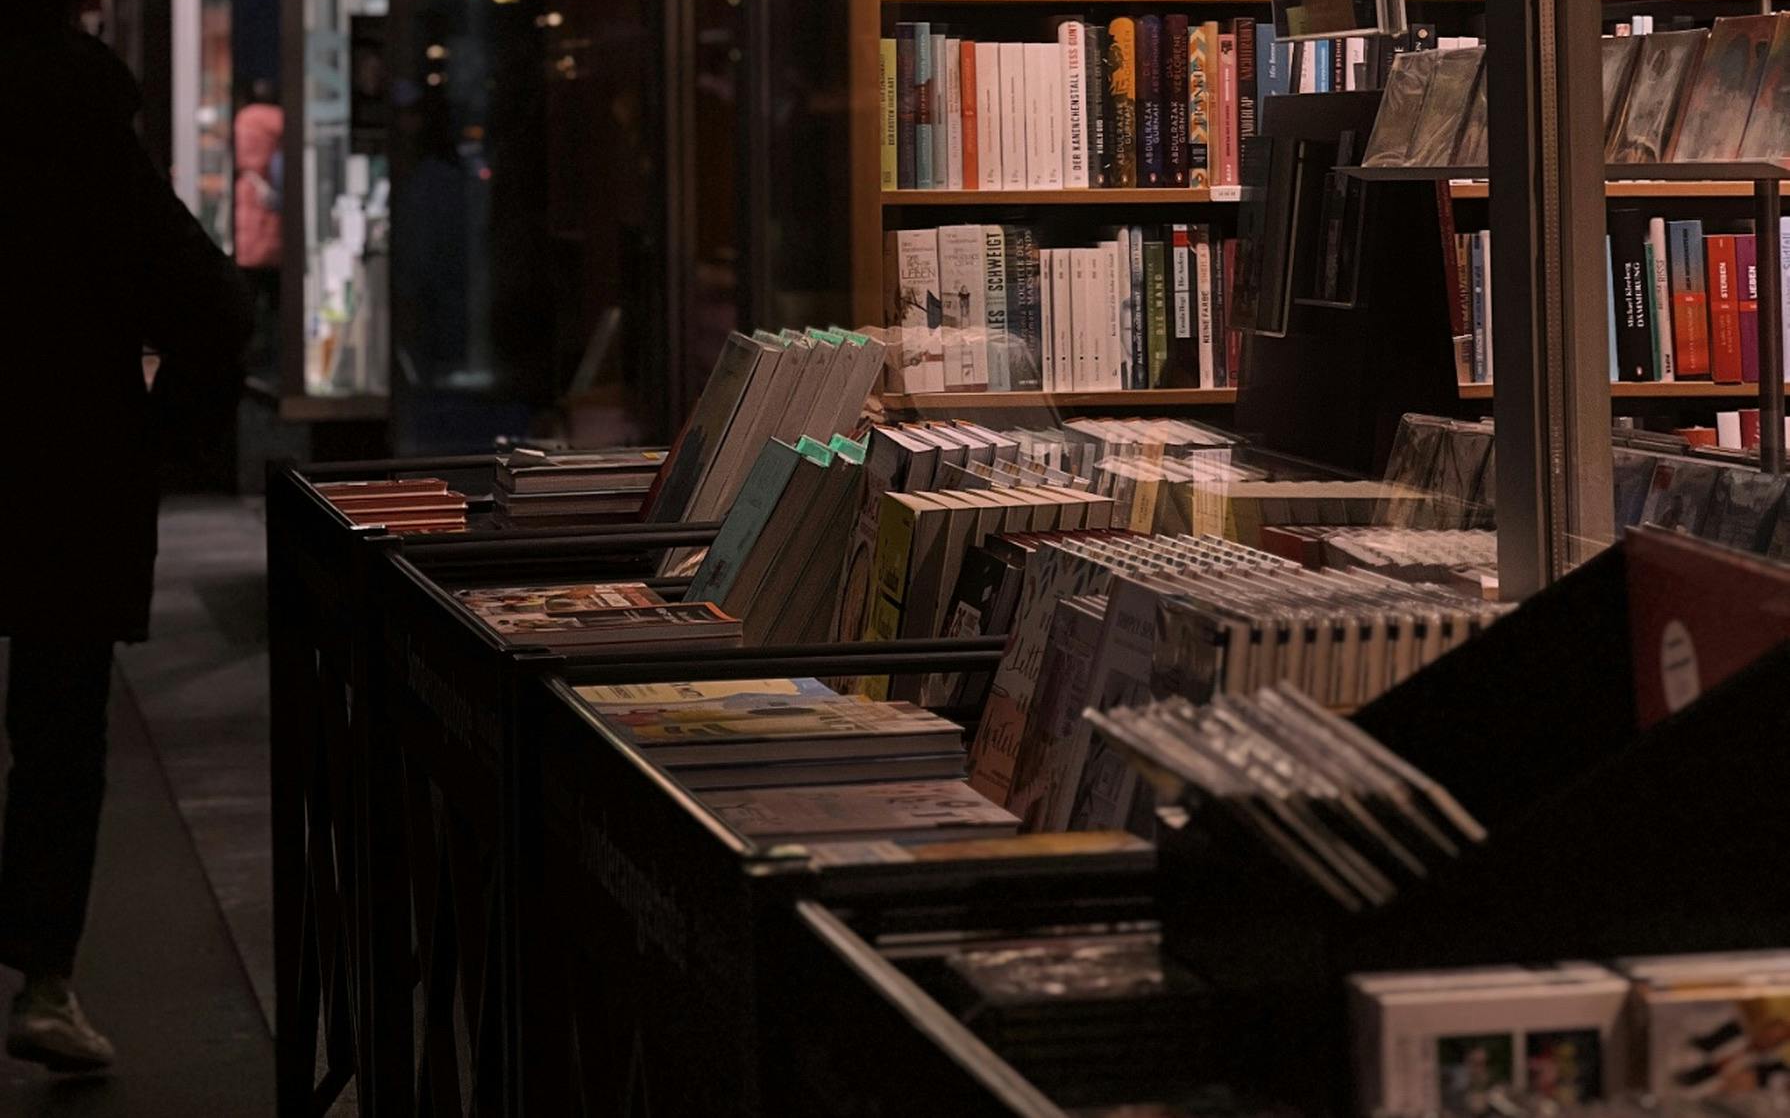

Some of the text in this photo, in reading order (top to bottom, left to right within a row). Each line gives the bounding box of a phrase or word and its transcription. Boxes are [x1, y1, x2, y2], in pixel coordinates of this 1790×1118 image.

[1173, 34, 1181, 93] VERLORENE
[1067, 23, 1081, 171] DER KANINCHENSTALL TESS GUNT
[1124, 104, 1132, 144] GURNAH
[1115, 102, 1125, 165] ABDULRAZAK
[1144, 101, 1153, 164] ABDULRAZAK
[1170, 101, 1179, 164] ABDULRAZAK
[986, 233, 1004, 291] SCHWEIGT
[1719, 263, 1728, 299] STERBEN
[1748, 266, 1758, 299] LIEBEN
[1154, 274, 1163, 335] DIE WAND
[1201, 291, 1209, 318] FARBE
[1625, 298, 1634, 327] Michael
